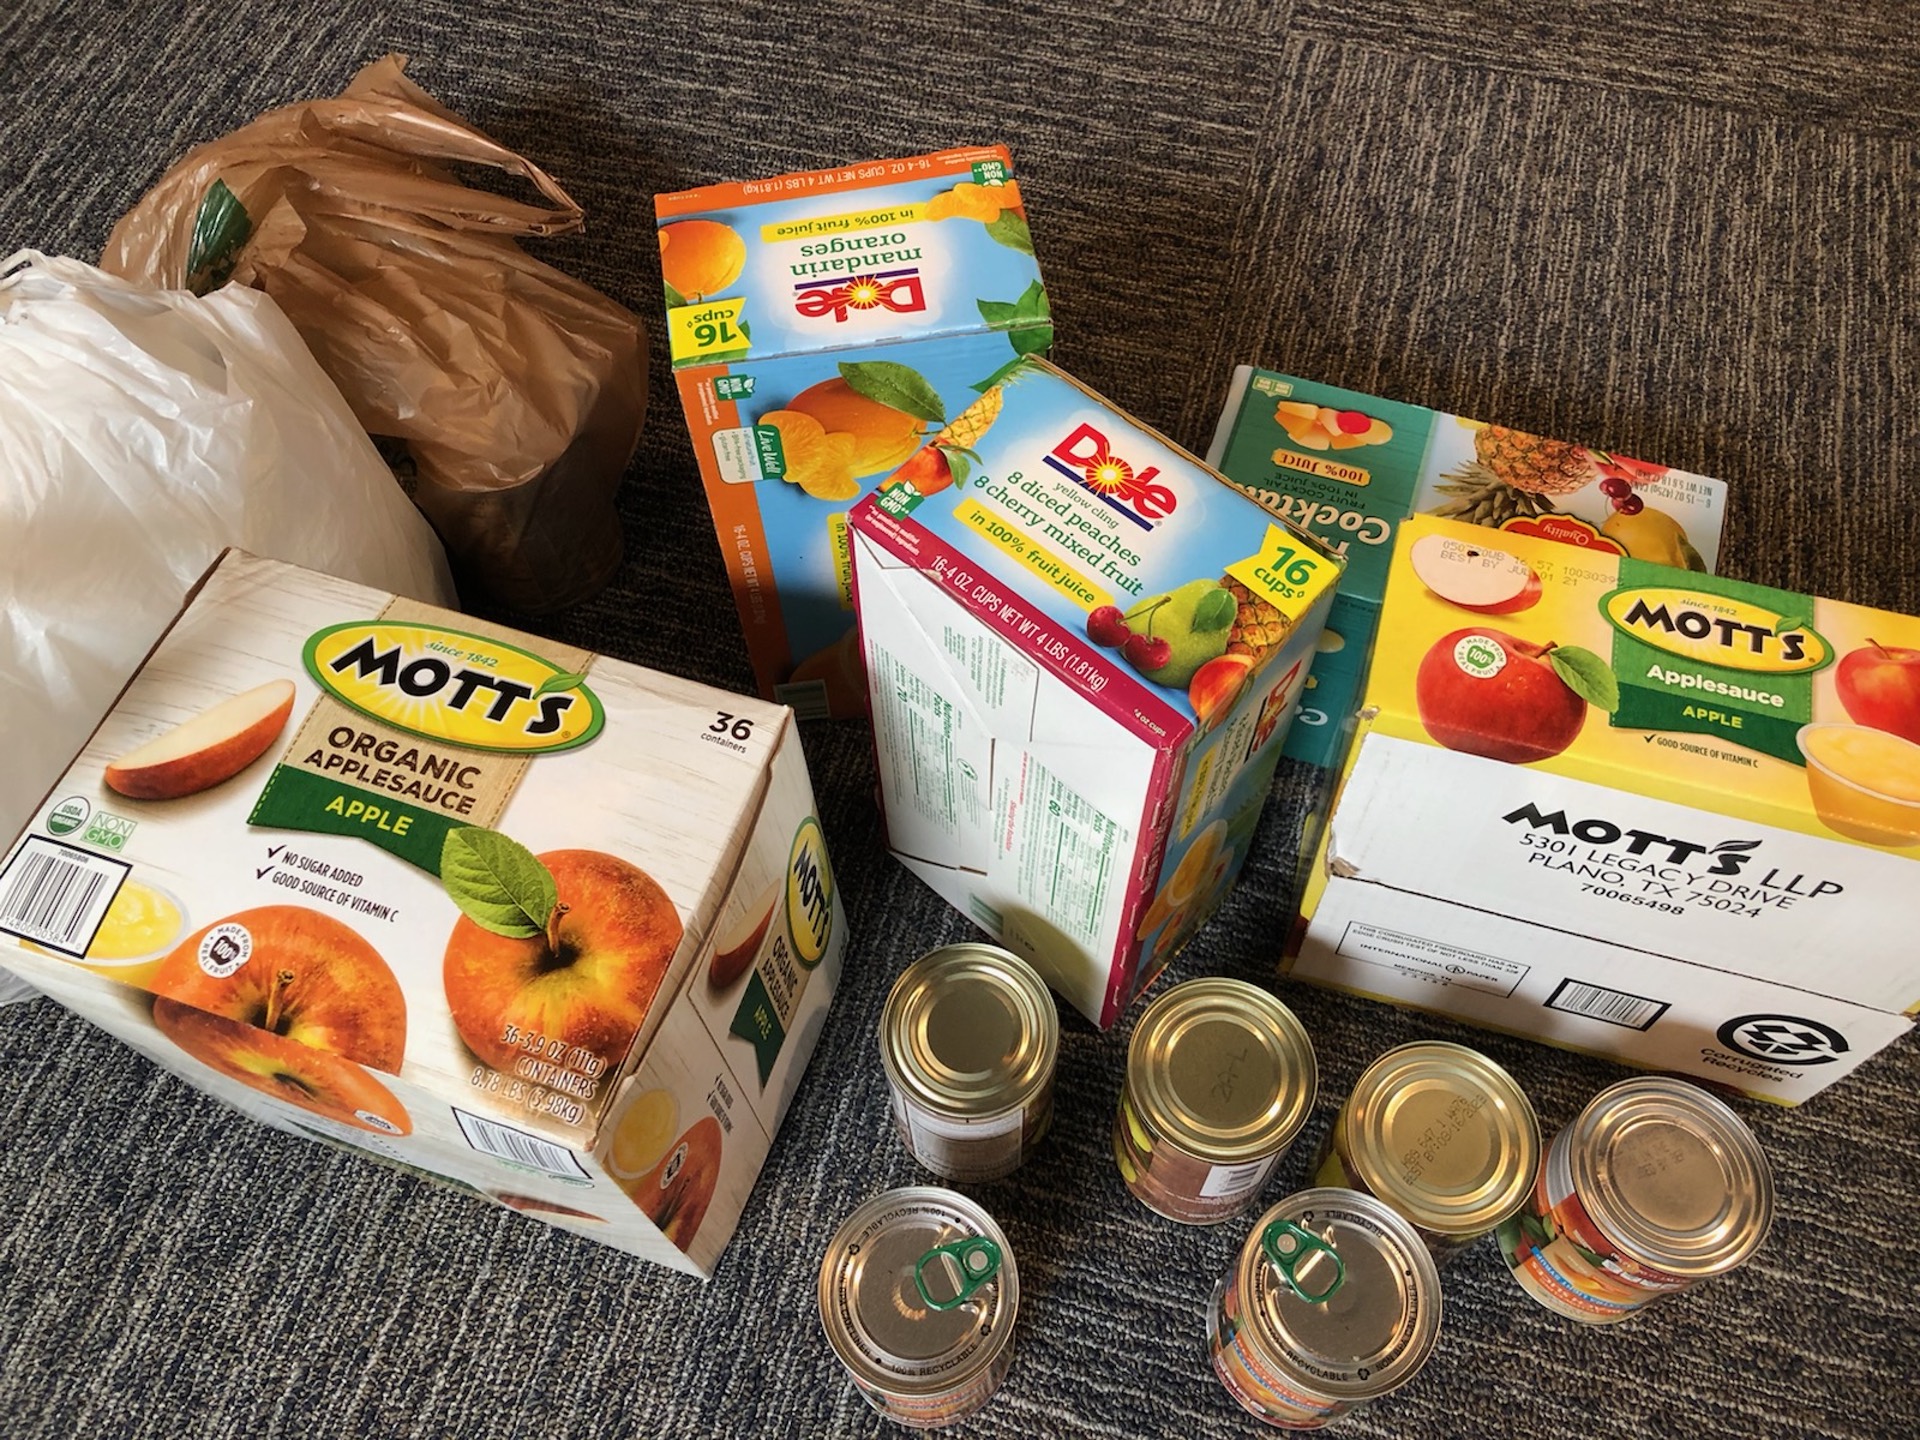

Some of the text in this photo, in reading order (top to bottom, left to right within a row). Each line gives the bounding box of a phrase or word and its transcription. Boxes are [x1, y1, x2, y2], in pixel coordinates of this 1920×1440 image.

[743, 158, 931, 195] 16-4 OZ. CUPS NET WT 4 LBS (1.81kg)
[984, 169, 1003, 179] NON
[777, 209, 914, 235] in 100% fruit juice
[801, 232, 906, 258] oranges
[790, 247, 922, 278] mandarin
[795, 276, 926, 323] Dole
[695, 322, 737, 347] 16
[757, 430, 781, 474] Live Well
[1281, 453, 1363, 483] 100% JUICE
[1051, 422, 1177, 519] Dole
[1275, 472, 1359, 498] IN 100% JUICE
[888, 488, 911, 506] NON
[1053, 482, 1120, 530] yellow cling
[1264, 477, 1366, 510] FRUIT COCKTAIL
[836, 523, 845, 532] in
[974, 475, 1144, 597] 8 cherry mixed fruit
[1007, 471, 1141, 567] 8 diced peaches
[1543, 524, 1589, 545] Quality
[970, 510, 1095, 603] in 100% fruit juice
[1271, 546, 1318, 586] 16
[1441, 552, 1578, 586] BEST BY 21
[931, 555, 1109, 692] 16-4 OZ. CUPS NET WT 4 LBS (1.81kg)
[1680, 598, 1737, 616] since 1842
[1624, 597, 1805, 661] MOTT'S
[426, 639, 500, 668] since 1842
[330, 637, 578, 734] MOTT'S
[897, 686, 907, 703] 70
[1647, 664, 1785, 708] Applesauce
[934, 692, 943, 718] Facts
[944, 701, 952, 739] Nutrition
[1682, 705, 1744, 729] APPLE
[701, 732, 746, 754] containers
[709, 711, 754, 741] 36
[1148, 722, 1166, 737] cups
[327, 726, 482, 790] ORGANIC
[1656, 736, 1759, 768] GOOD SOURCE OF VITAMIN C
[304, 750, 476, 815] APPLESAUCE
[61, 804, 83, 817] USDA
[95, 814, 131, 833] NON
[325, 795, 414, 836] APPLE
[1048, 800, 1061, 816] 60
[85, 828, 124, 848] GMO
[1102, 818, 1117, 855] Nutrition
[1501, 802, 1844, 900] MOTT'S LLP
[282, 851, 364, 888] NO SUGAR ADDED
[1519, 832, 1806, 911] 5301 LEGACY DRIVE
[1528, 852, 1763, 918] PLANO, TX 75024
[272, 871, 400, 923] GOOD SOURCE OF VITAMIN C
[1580, 882, 1685, 916] 70065498
[201, 942, 233, 975] REAL FRUIT
[213, 939, 240, 961] 100%
[217, 926, 251, 958] MADE FROM
[1352, 929, 1375, 938] EDGE
[1376, 934, 1404, 946] CRUSH
[1406, 942, 1426, 951] TEST
[1439, 950, 1456, 958] NOT
[1457, 955, 1479, 965] LESS
[1480, 961, 1502, 971] THAN
[1359, 925, 1376, 934] THIS
[1378, 929, 1434, 948] CORRUGATED
[1488, 957, 1505, 966] HAS
[773, 935, 798, 998] ORGANIC
[1360, 943, 1443, 968] INTERNATIONAL
[1466, 970, 1498, 982] PAPER
[762, 958, 790, 1021] APPLESAUCE
[501, 1024, 608, 1078] 36-3.9 OZ (111g)
[1700, 1048, 1804, 1079] Corrugated
[515, 1056, 598, 1099] CONTAINERS
[1702, 1056, 1784, 1082] Recycles
[471, 1067, 586, 1125] 8.78 LBS (3.98kg)
[862, 1206, 919, 1239] RECYCLABLE
[890, 1342, 979, 1376] 100% RECYCLABLE
[1285, 1350, 1348, 1381] RECYCLABLE
[1376, 1354, 1395, 1371] NON
